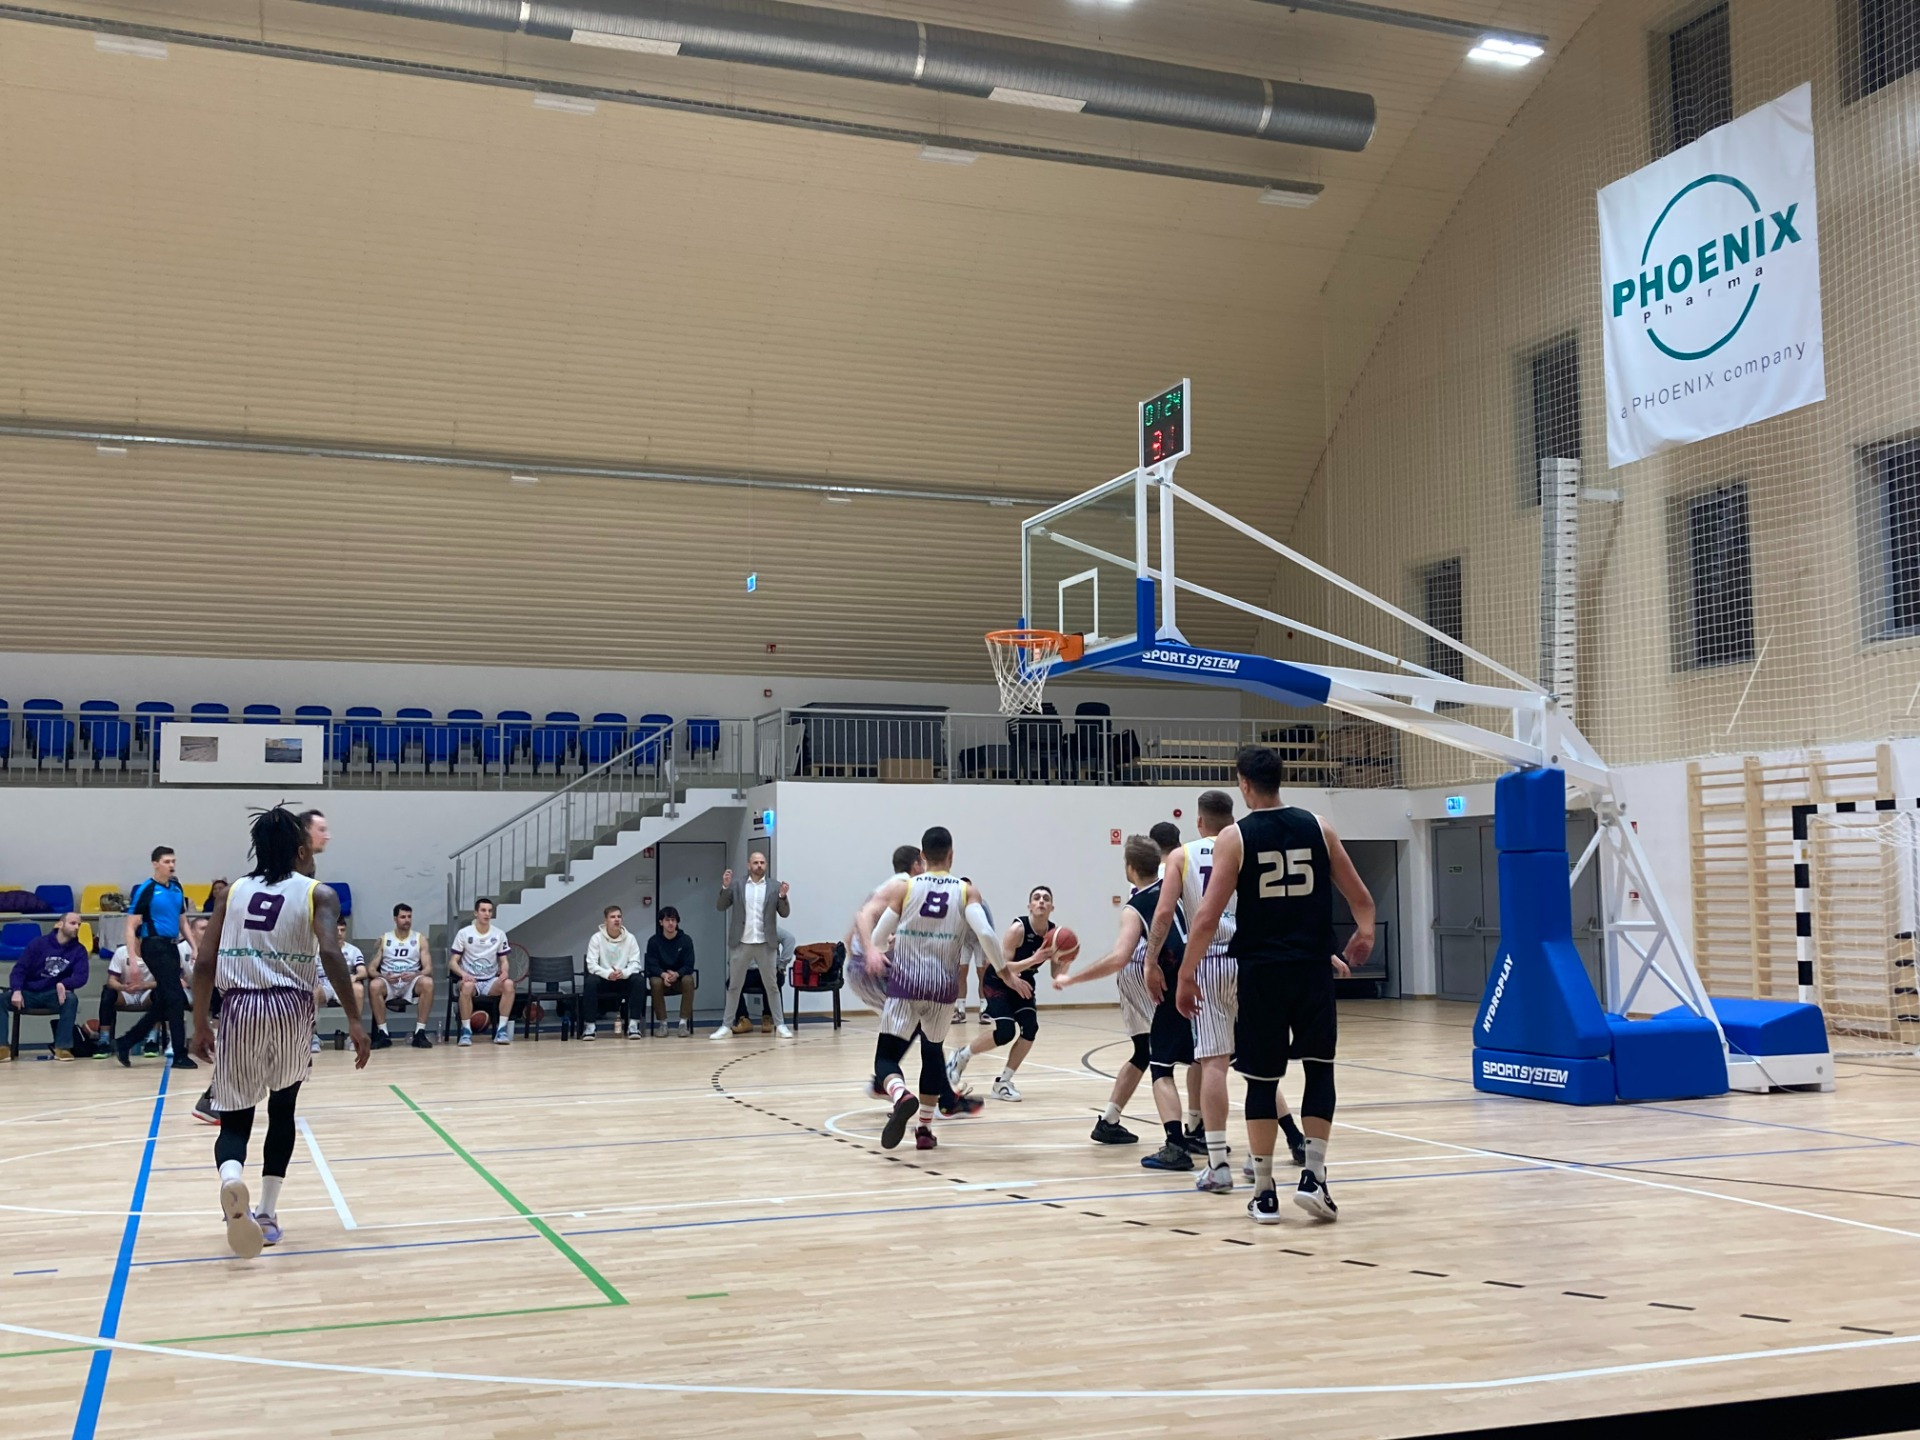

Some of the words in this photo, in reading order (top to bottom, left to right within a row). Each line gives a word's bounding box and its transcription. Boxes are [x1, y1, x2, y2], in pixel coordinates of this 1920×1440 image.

[1612, 202, 1802, 318] PHOENIX
[1620, 406, 1628, 419] a
[1632, 371, 1715, 413] PHOENIX
[1723, 341, 1806, 383] company
[1257, 848, 1314, 899] 25
[243, 891, 286, 932] 9
[919, 891, 950, 919] 8
[394, 948, 409, 957] 10
[1482, 953, 1514, 1034] HYDROPLAY
